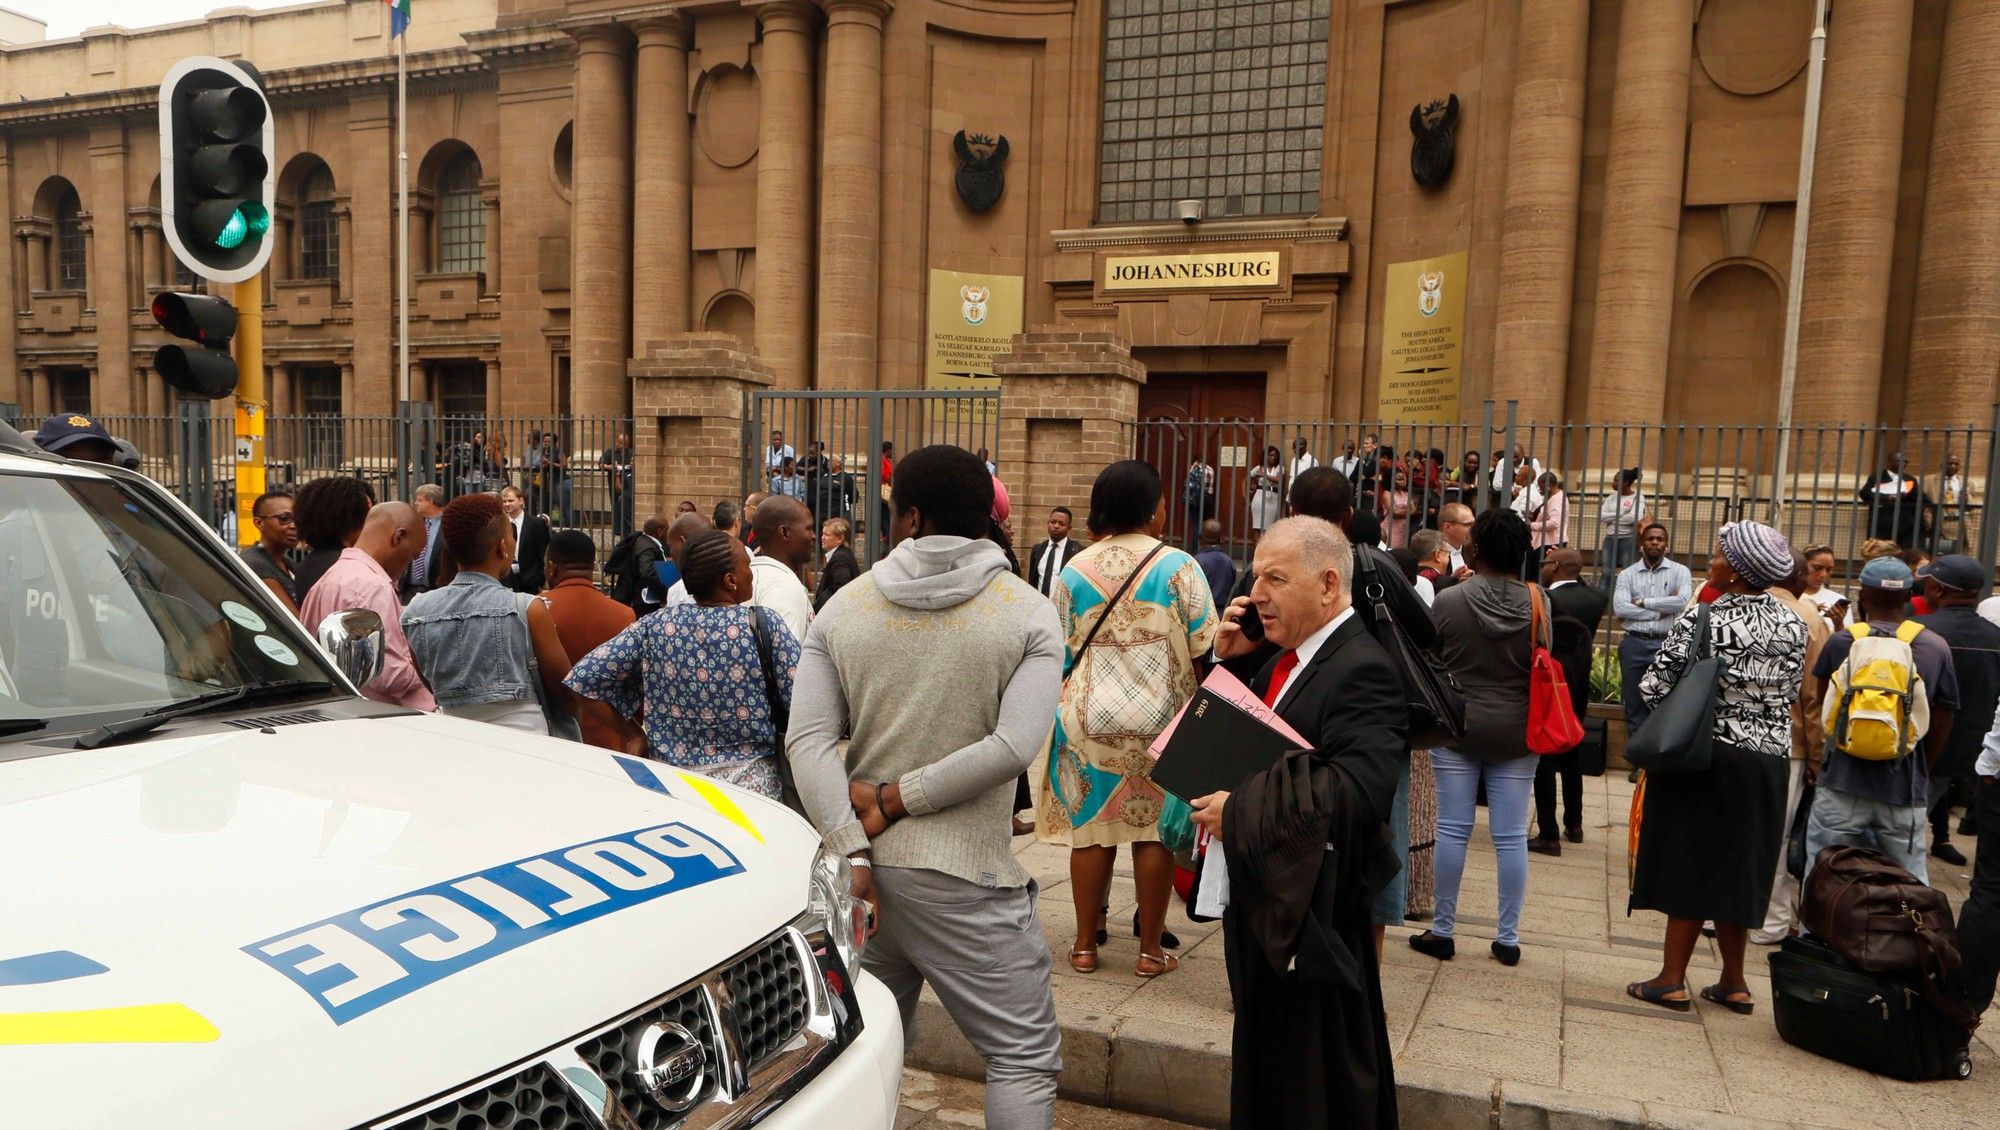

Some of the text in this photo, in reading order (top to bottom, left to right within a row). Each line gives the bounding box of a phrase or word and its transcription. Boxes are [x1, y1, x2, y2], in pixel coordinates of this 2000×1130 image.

[1112, 261, 1271, 281] JOHANNESBURG
[1428, 336, 1445, 344] AFRICA
[936, 351, 986, 359] JOHANNESBURG
[1391, 347, 1418, 355] GAUTENG
[1419, 345, 1436, 353] LOCAL
[1405, 353, 1445, 363] JOHANNESBURG
[26, 588, 110, 623] POLE
[1194, 699, 1210, 718] 2019
